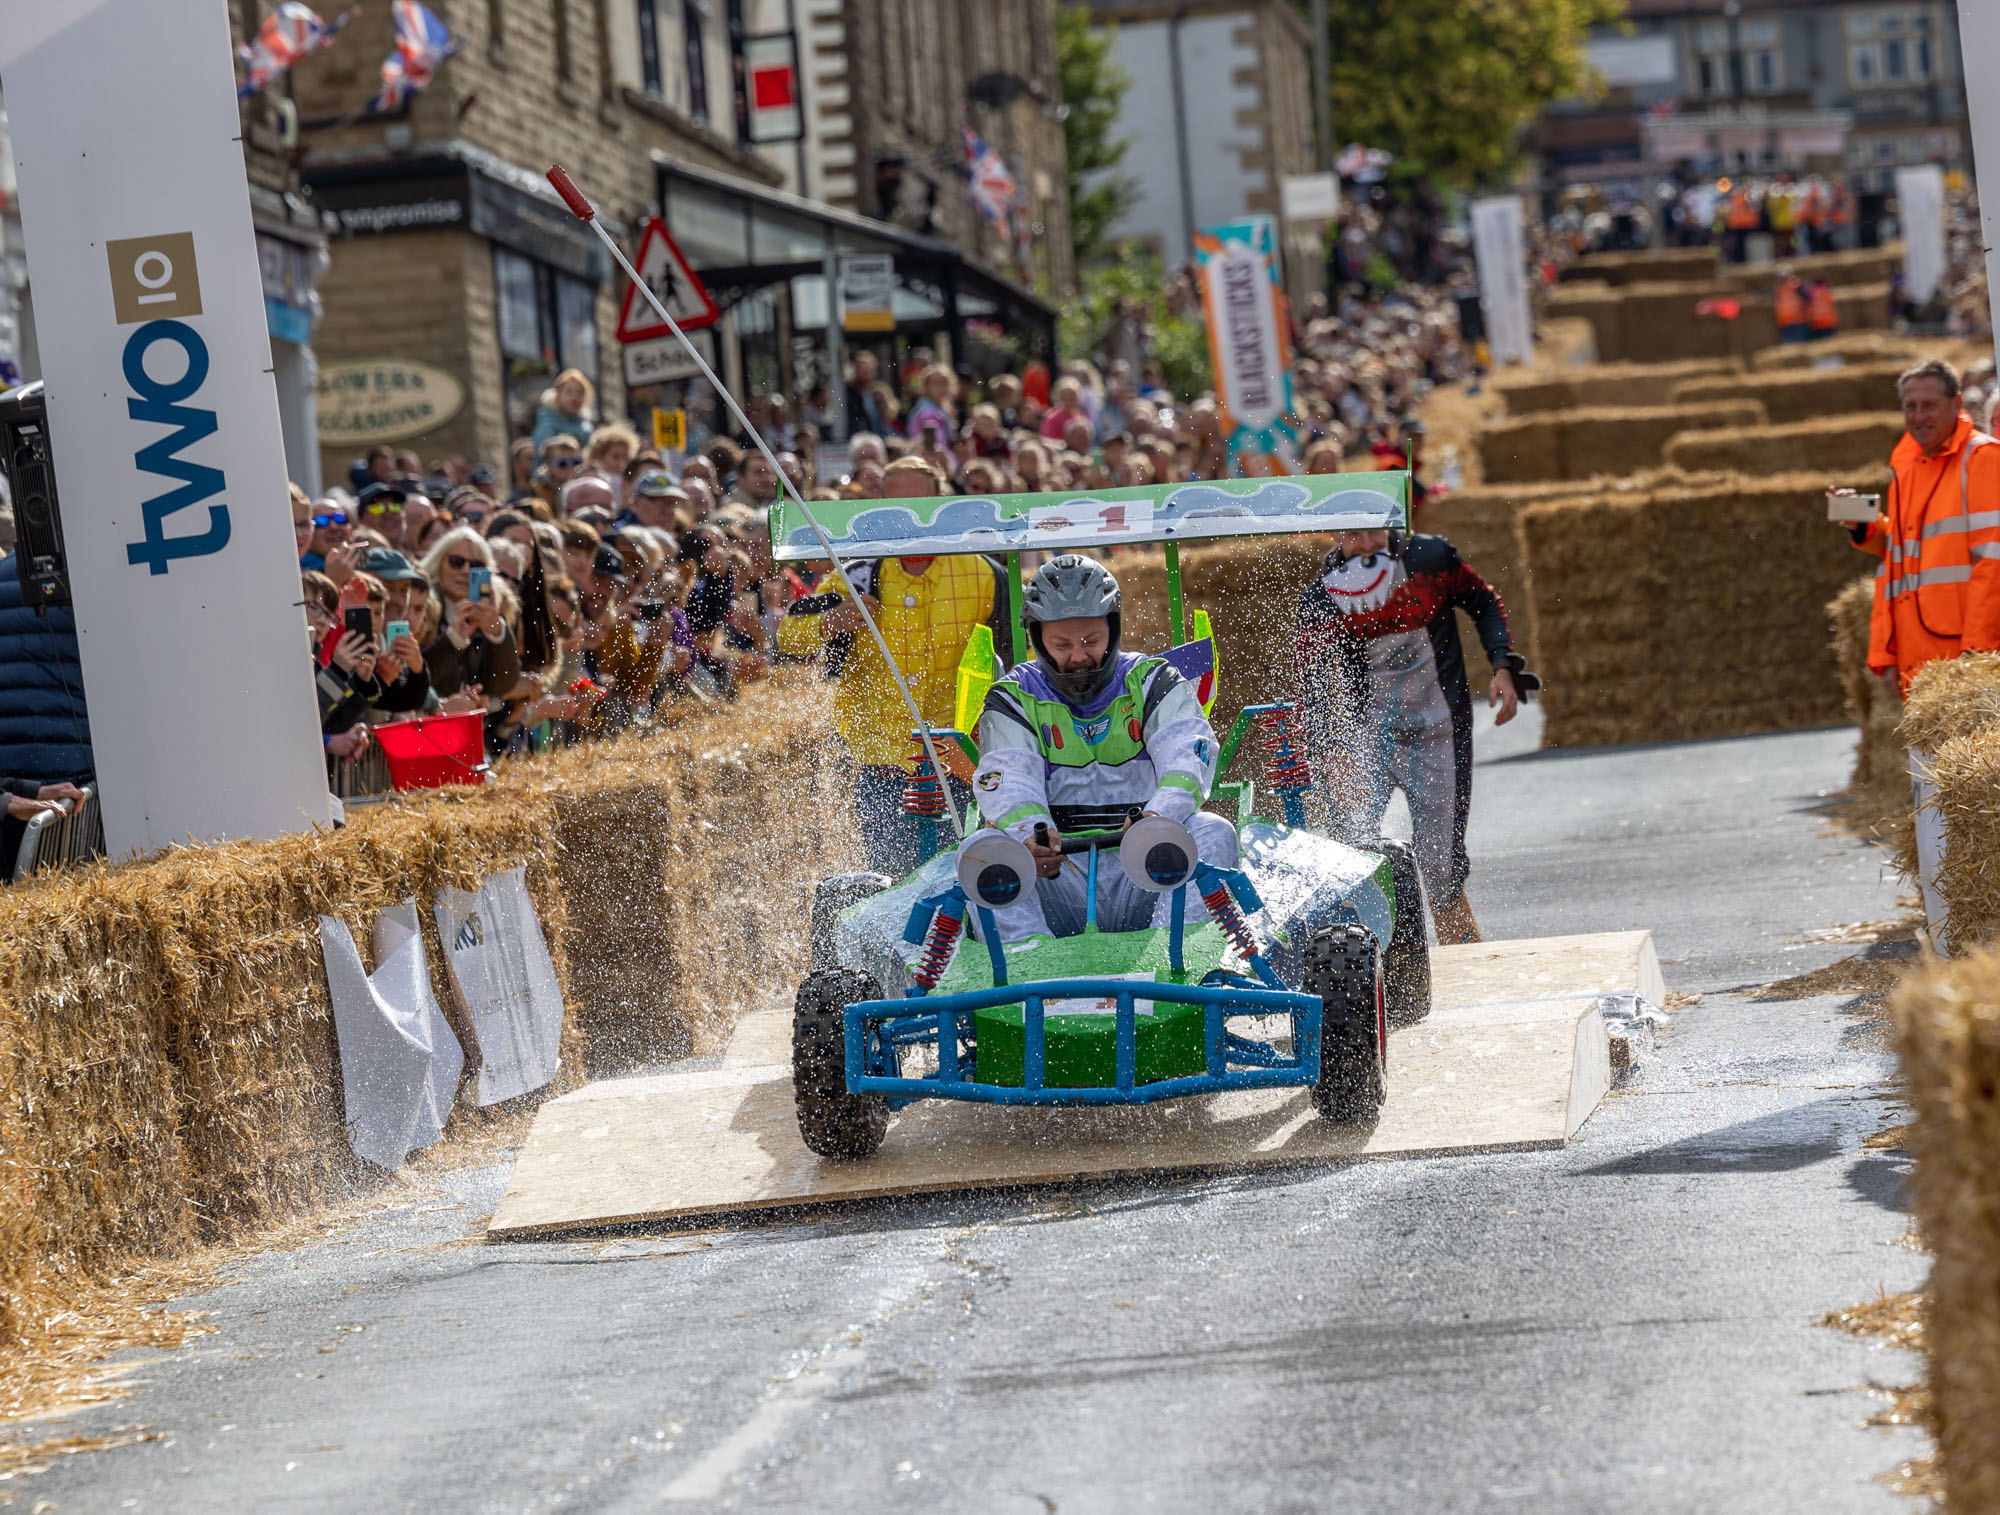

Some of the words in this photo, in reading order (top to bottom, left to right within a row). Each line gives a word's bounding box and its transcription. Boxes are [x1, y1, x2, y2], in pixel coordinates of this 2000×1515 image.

[339, 197, 462, 233] ompromise
[1223, 259, 1271, 410] BLACKSTICKS
[317, 371, 425, 394] LOWERS
[317, 402, 433, 431] CCASIONS
[122, 319, 231, 575] two
[1097, 506, 1130, 532] 1
